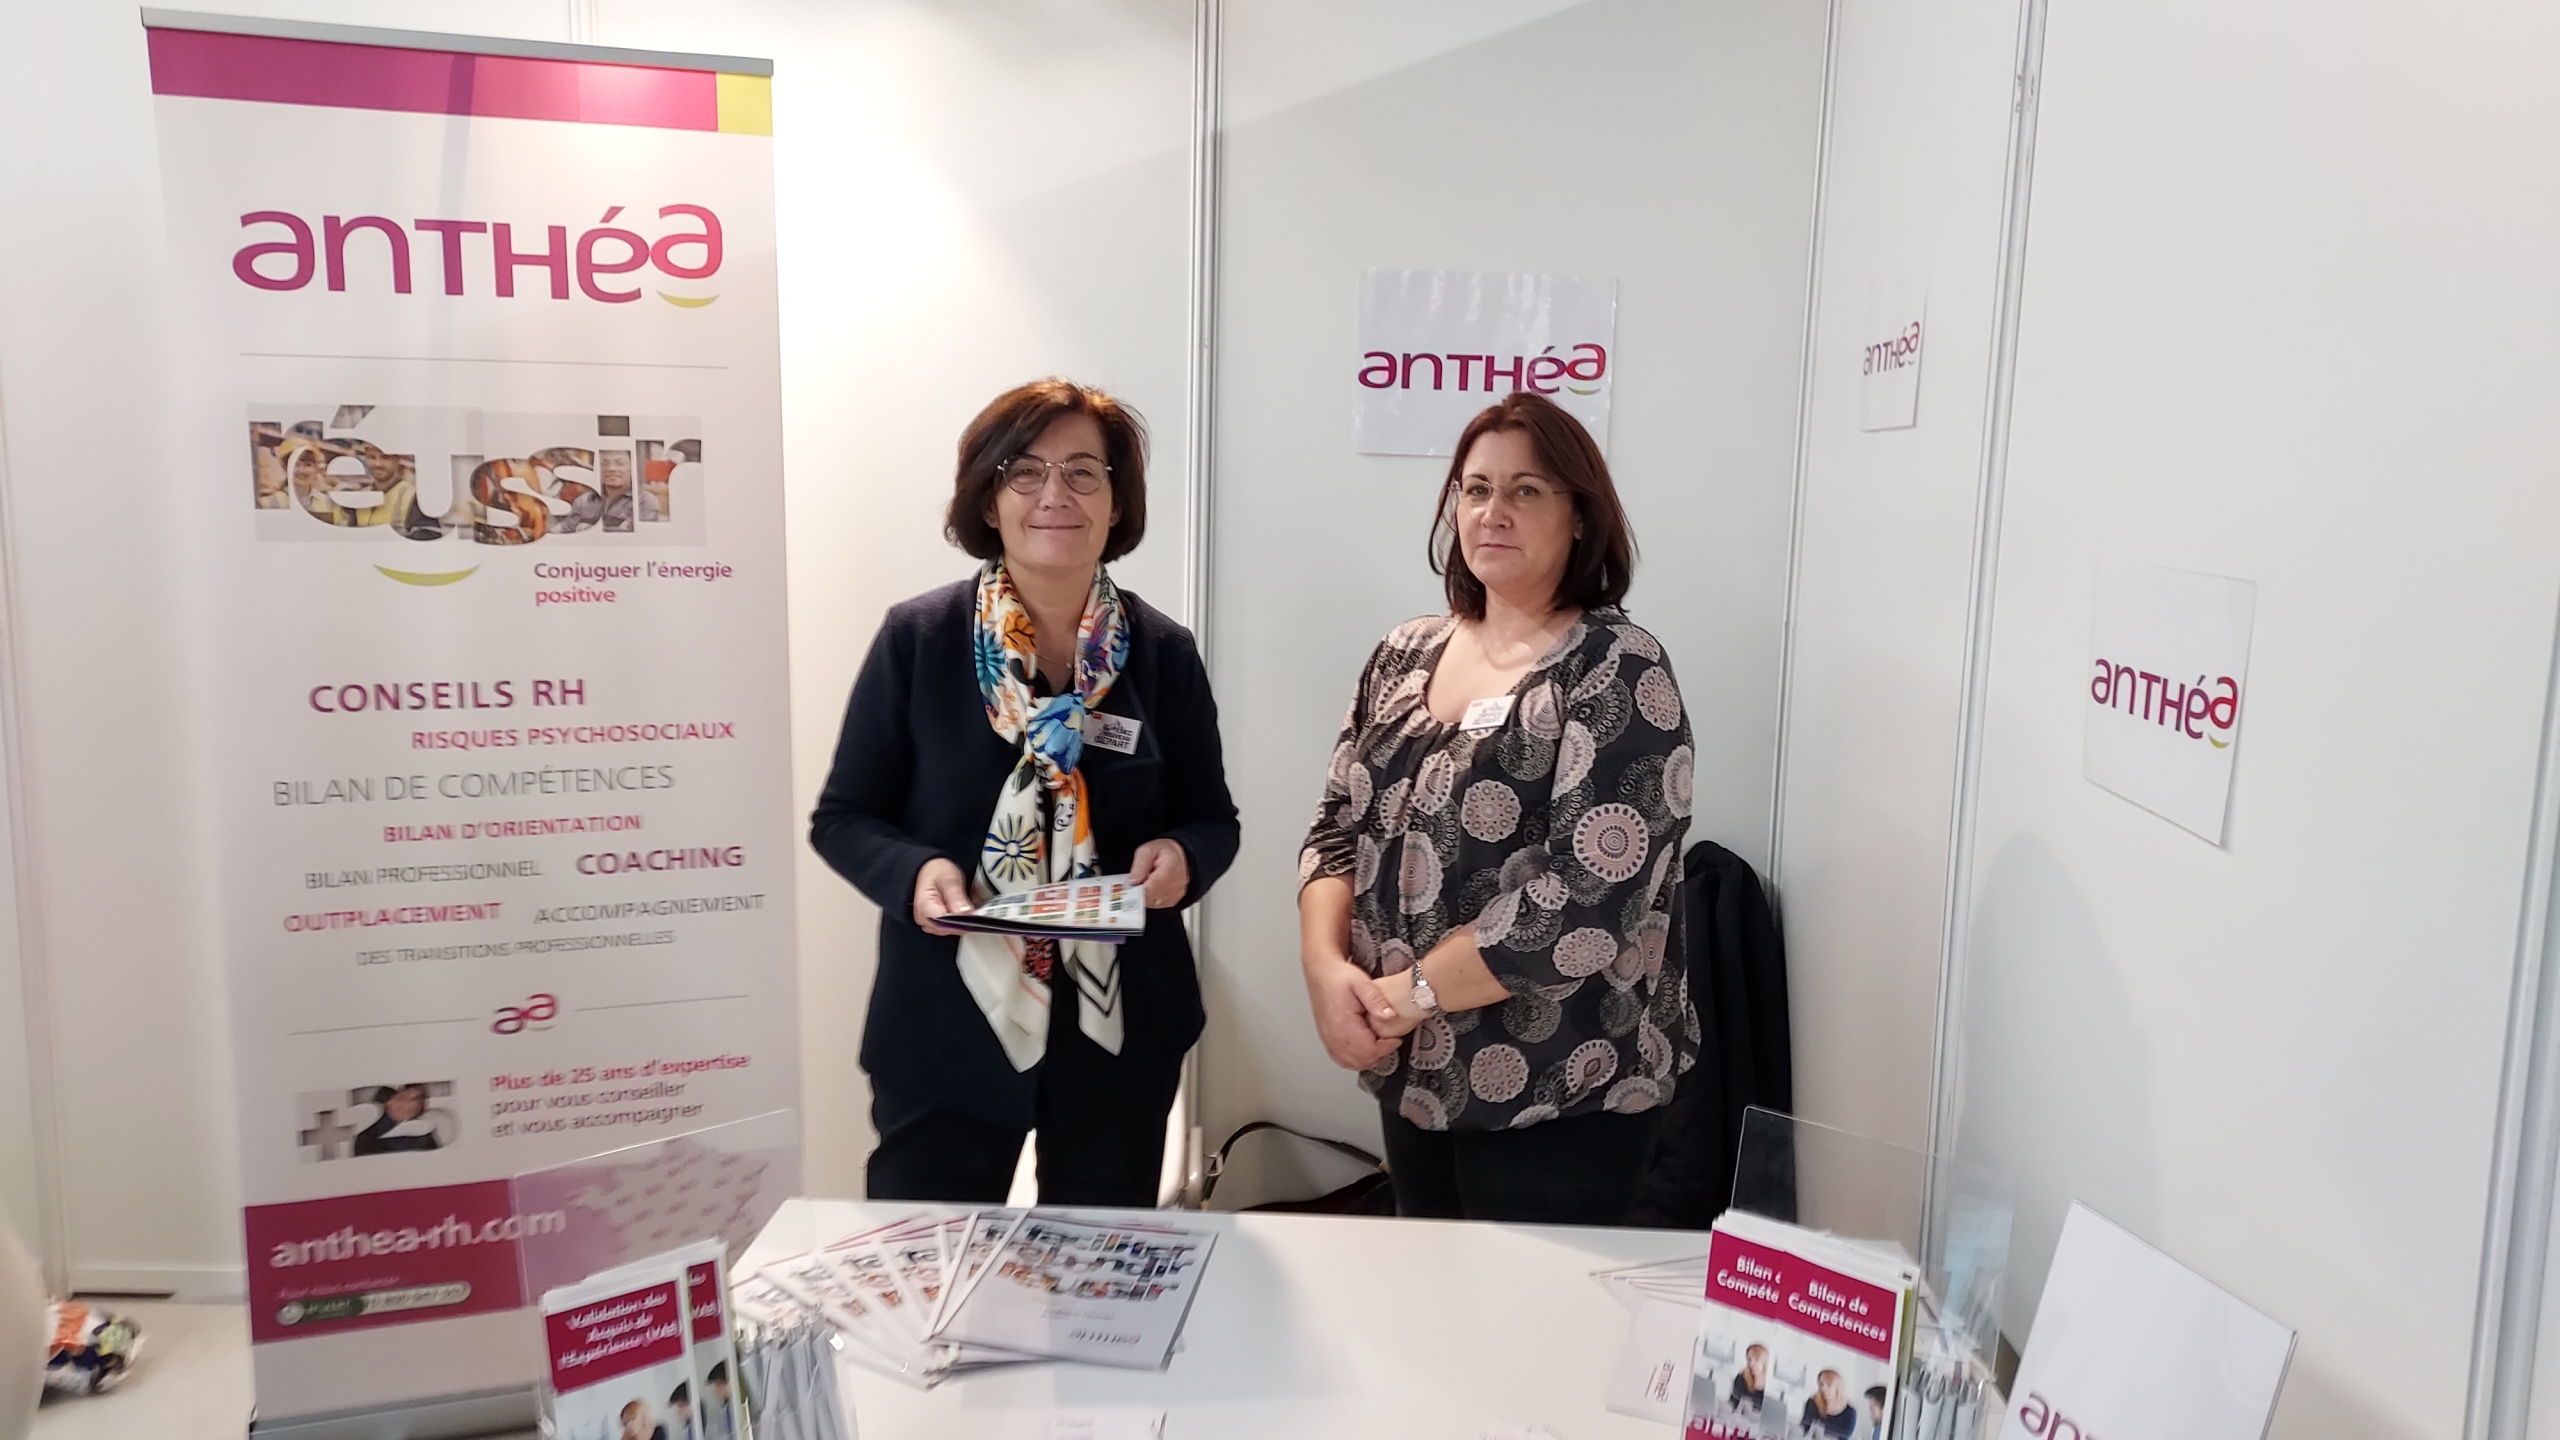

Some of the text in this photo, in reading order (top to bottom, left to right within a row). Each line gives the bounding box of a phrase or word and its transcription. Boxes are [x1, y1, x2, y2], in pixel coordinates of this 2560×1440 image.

[248, 404, 702, 546] réussir
[533, 561, 732, 582] Conjuguer l'énergie
[535, 587, 617, 607] positive
[308, 678, 587, 713] CONSEILS RH
[411, 721, 737, 751] RISQUES PSYCHOSOCIAUX
[273, 764, 678, 807] BILAN DE COMPÉTENCES
[383, 814, 644, 843] BILAN D'ORIENTATION
[305, 859, 544, 890] BILAN PROFESSIONNEL
[575, 845, 745, 876] COACHING
[283, 901, 503, 933] OUTPLACEMENT
[533, 893, 767, 925] ACCOMPAGNEMENT
[396, 942, 514, 963] TRANSITIONS
[514, 929, 678, 954] PROFESSIONNELLES
[489, 1072, 534, 1092] Plus
[539, 1068, 565, 1087] de
[570, 1066, 597, 1085] 25
[601, 1065, 638, 1082] ans
[490, 1081, 687, 1119] pour vous conseiller
[490, 1103, 705, 1138] et vous accompagner
[269, 1209, 568, 1269] anthea-rh.com
[1736, 1254, 1773, 1283] Bilan
[1716, 1268, 1780, 1305] Compéte
[1807, 1278, 1870, 1317] Bilan de
[1787, 1292, 1888, 1343] Compétences
